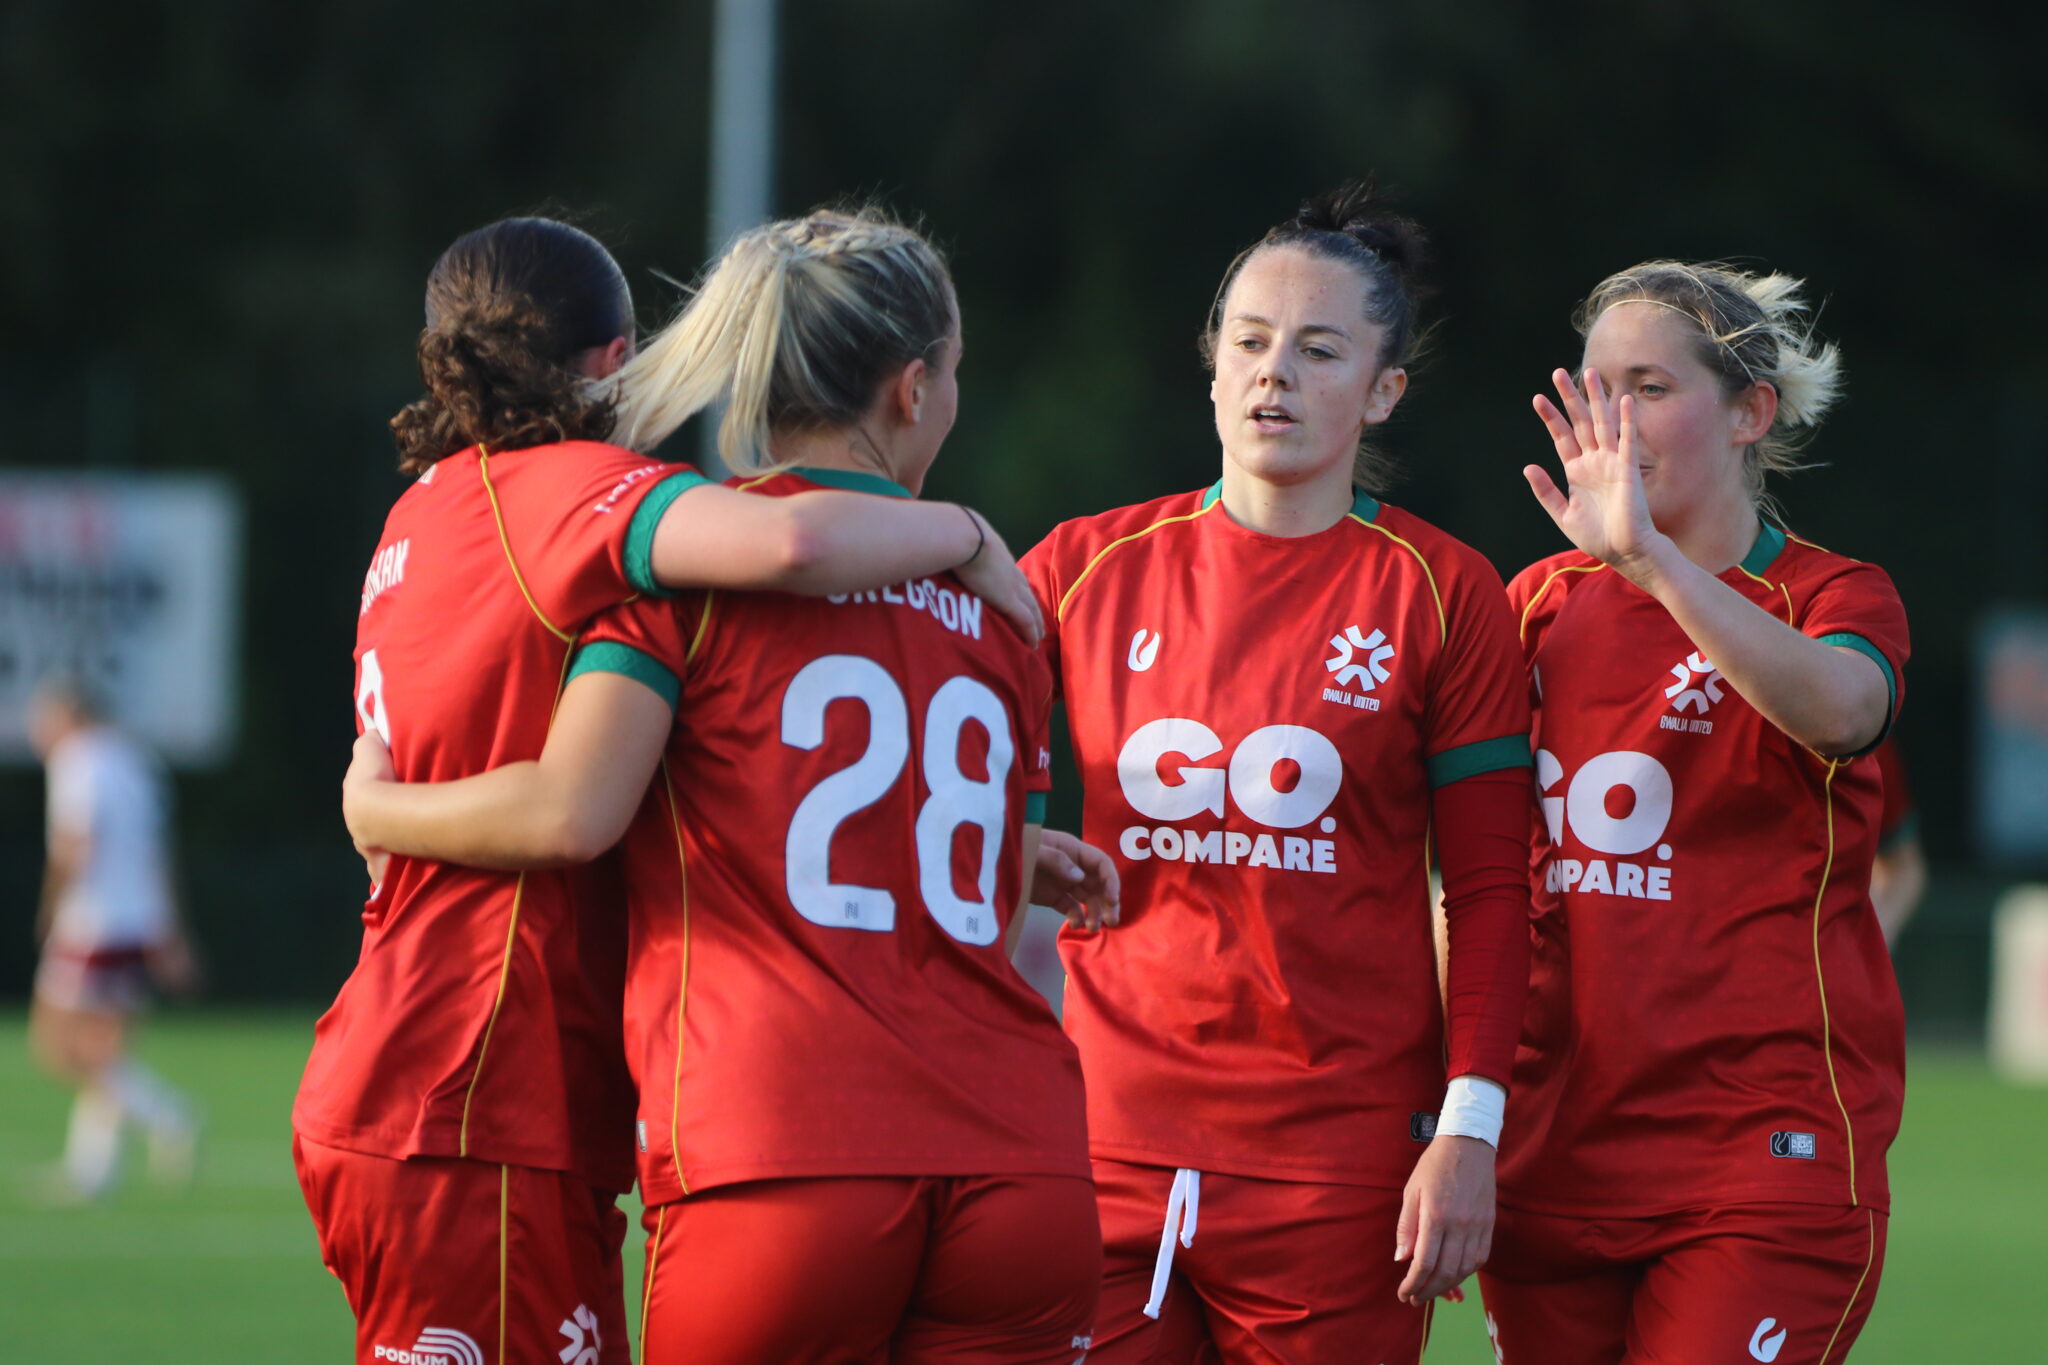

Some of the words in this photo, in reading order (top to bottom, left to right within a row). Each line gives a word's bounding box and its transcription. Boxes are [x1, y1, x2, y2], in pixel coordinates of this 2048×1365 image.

[1322, 687, 1352, 706] GWALIA
[1353, 694, 1380, 712] UNITED
[1659, 714, 1688, 732] GWALIA
[1689, 719, 1713, 735] UNITED
[781, 654, 1014, 947] 28
[1119, 825, 1337, 873] COMPARE
[374, 1344, 449, 1365] PODIUM
